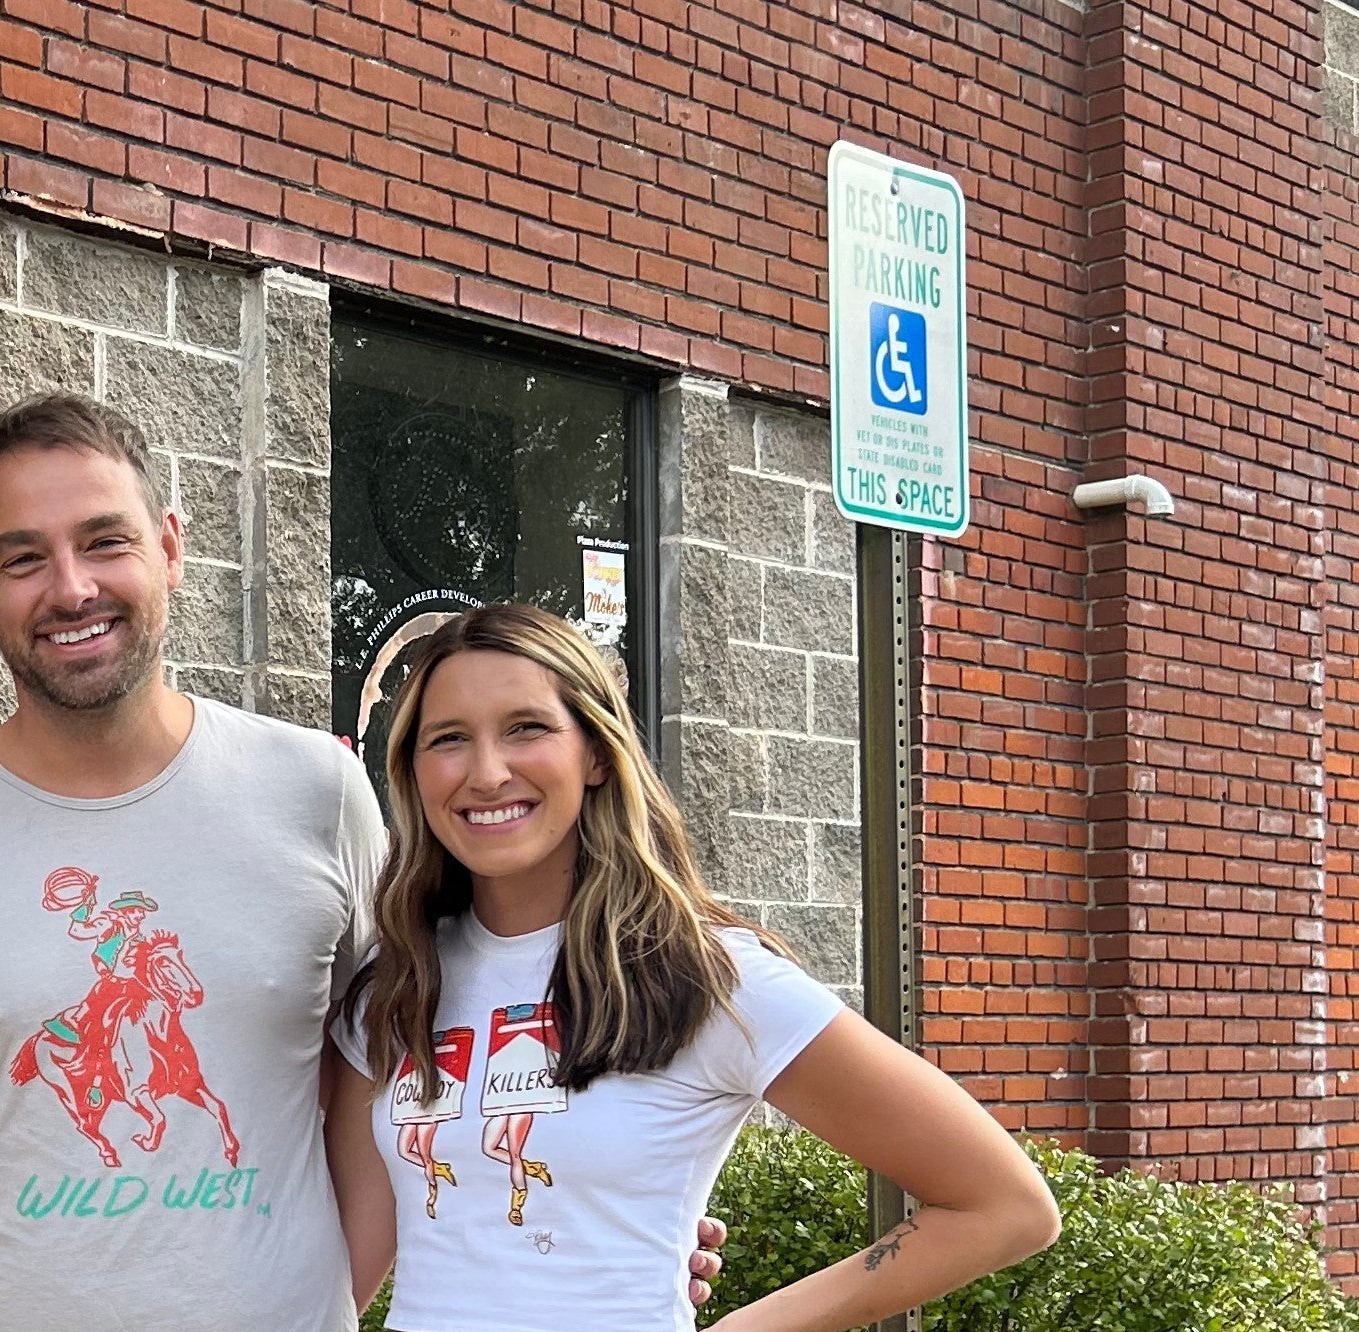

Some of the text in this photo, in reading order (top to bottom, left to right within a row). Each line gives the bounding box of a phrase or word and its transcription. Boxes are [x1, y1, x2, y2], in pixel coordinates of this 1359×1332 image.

[845, 183, 948, 255] RESERVED
[853, 243, 941, 309] PARKING
[871, 414, 928, 437] VEHICLES WITH
[858, 447, 879, 463] STATE
[883, 453, 919, 472] DISABLED
[847, 466, 955, 518] THIS SPACE
[366, 603, 403, 646] PHILLIPS
[403, 589, 439, 608] CAREER
[440, 588, 486, 609] DEVELOP
[487, 1067, 555, 1096] KILLERS
[16, 1167, 259, 1220] WILD WEST
